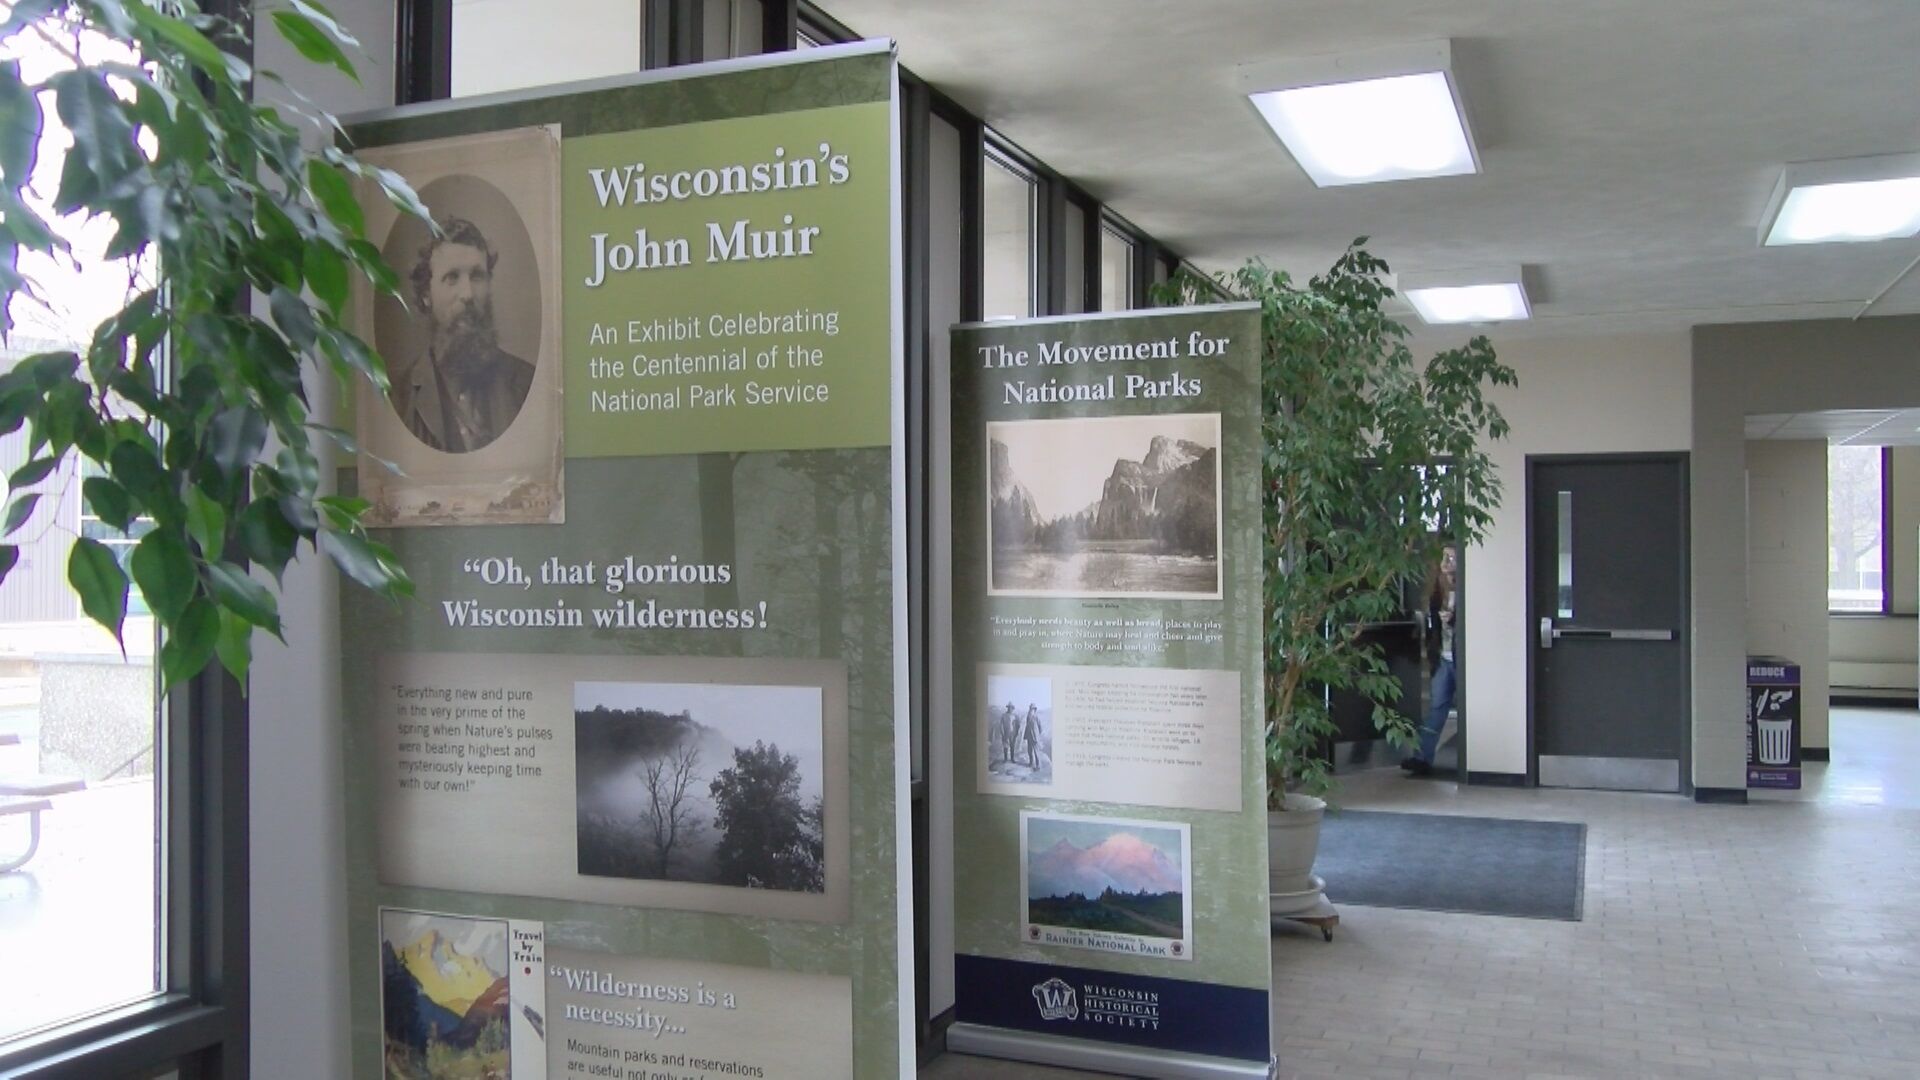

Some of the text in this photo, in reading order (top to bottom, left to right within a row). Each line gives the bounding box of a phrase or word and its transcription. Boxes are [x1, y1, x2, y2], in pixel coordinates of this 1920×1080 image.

[588, 143, 851, 208] Wisconsin’s
[584, 213, 820, 287] John Muir
[589, 308, 840, 346] An Exhibit Celebrating
[978, 330, 1232, 370] The Movement for
[589, 344, 824, 379] the Centennial of the
[591, 378, 830, 413] National Park Service
[1003, 370, 1203, 406] National Parks
[463, 554, 733, 594] “Oh, that glorious
[442, 599, 769, 630] Wisconsin wilderness!
[1106, 617, 1123, 627] well
[1165, 619, 1191, 630] places
[1193, 620, 1203, 629] to
[1204, 620, 1222, 631] play
[1084, 641, 1105, 653] body
[1187, 632, 1203, 641] and
[1205, 633, 1223, 644] give
[1749, 666, 1786, 678] REDUCE
[455, 690, 477, 701] new
[481, 687, 504, 701] and
[507, 689, 534, 702] pure
[398, 704, 526, 720] in the very prime of the
[398, 723, 430, 738] spring
[433, 723, 462, 737] when
[516, 726, 553, 740] pulses
[398, 742, 537, 759] were beating highest and
[399, 760, 543, 778] mysteriously keeping time
[399, 776, 421, 790] with
[423, 780, 442, 791] our
[513, 929, 543, 942] Travel
[521, 941, 534, 953] by
[513, 952, 543, 963] Train
[550, 965, 737, 1010] “Wilderness is a
[1083, 984, 1159, 1002] WISCONSIN
[1084, 998, 1160, 1017] HISTORICAL
[565, 1003, 687, 1038] necessity...
[1084, 1012, 1160, 1031] SOCIETY
[567, 1038, 764, 1079] Mountain parks and reservations
[567, 1059, 585, 1072] are
[588, 1063, 623, 1079] useful
[627, 1069, 647, 1080] not
